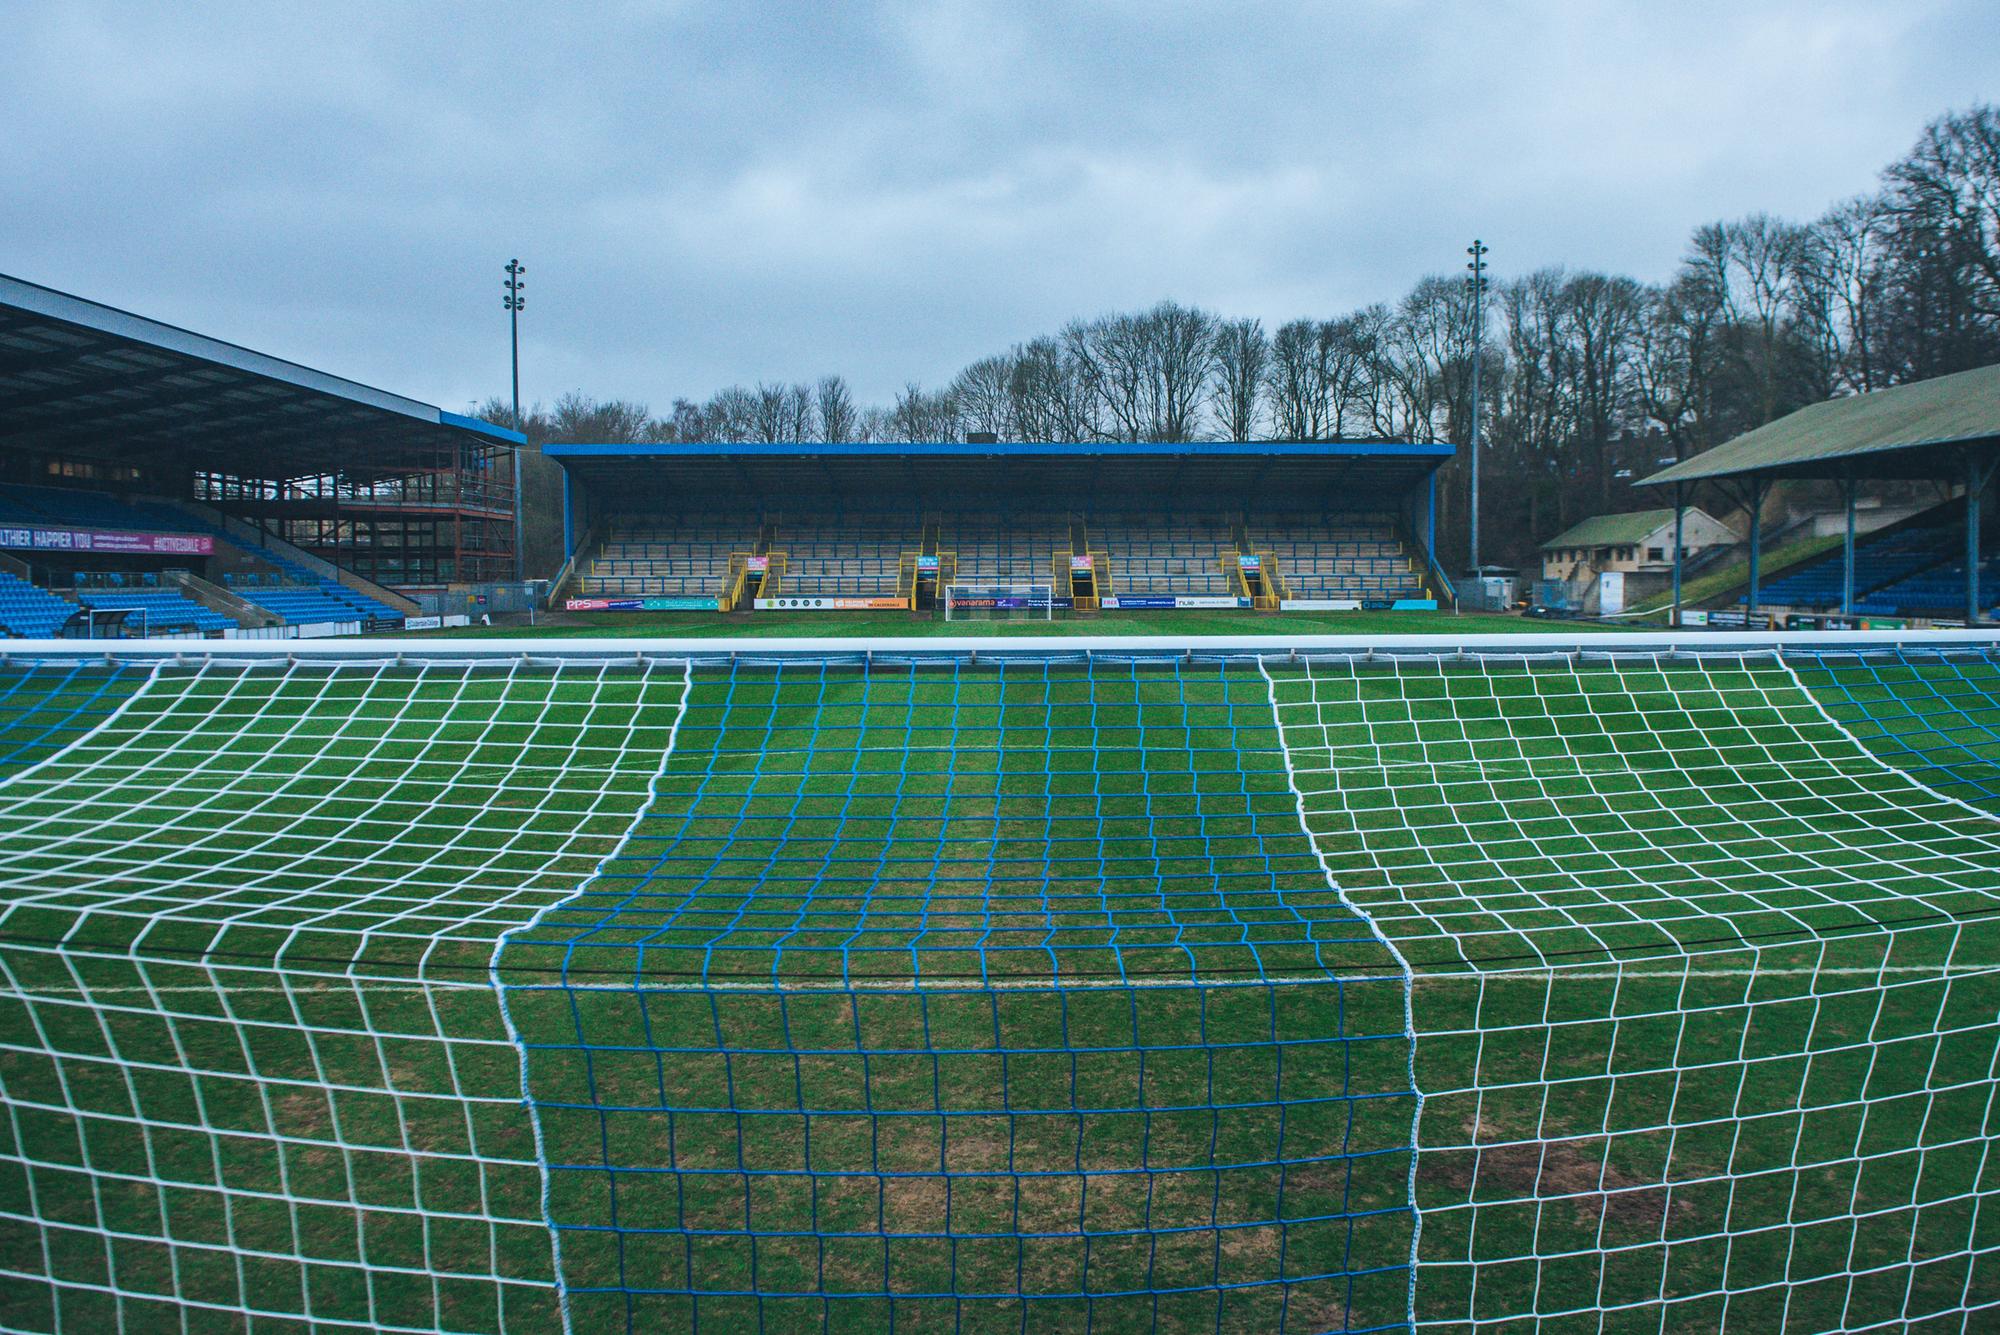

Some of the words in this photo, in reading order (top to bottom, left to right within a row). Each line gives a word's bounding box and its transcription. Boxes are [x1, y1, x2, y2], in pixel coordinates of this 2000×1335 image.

[34, 531, 71, 548] HAPPIER
[74, 533, 91, 549] YOU
[566, 599, 592, 610] PPS
